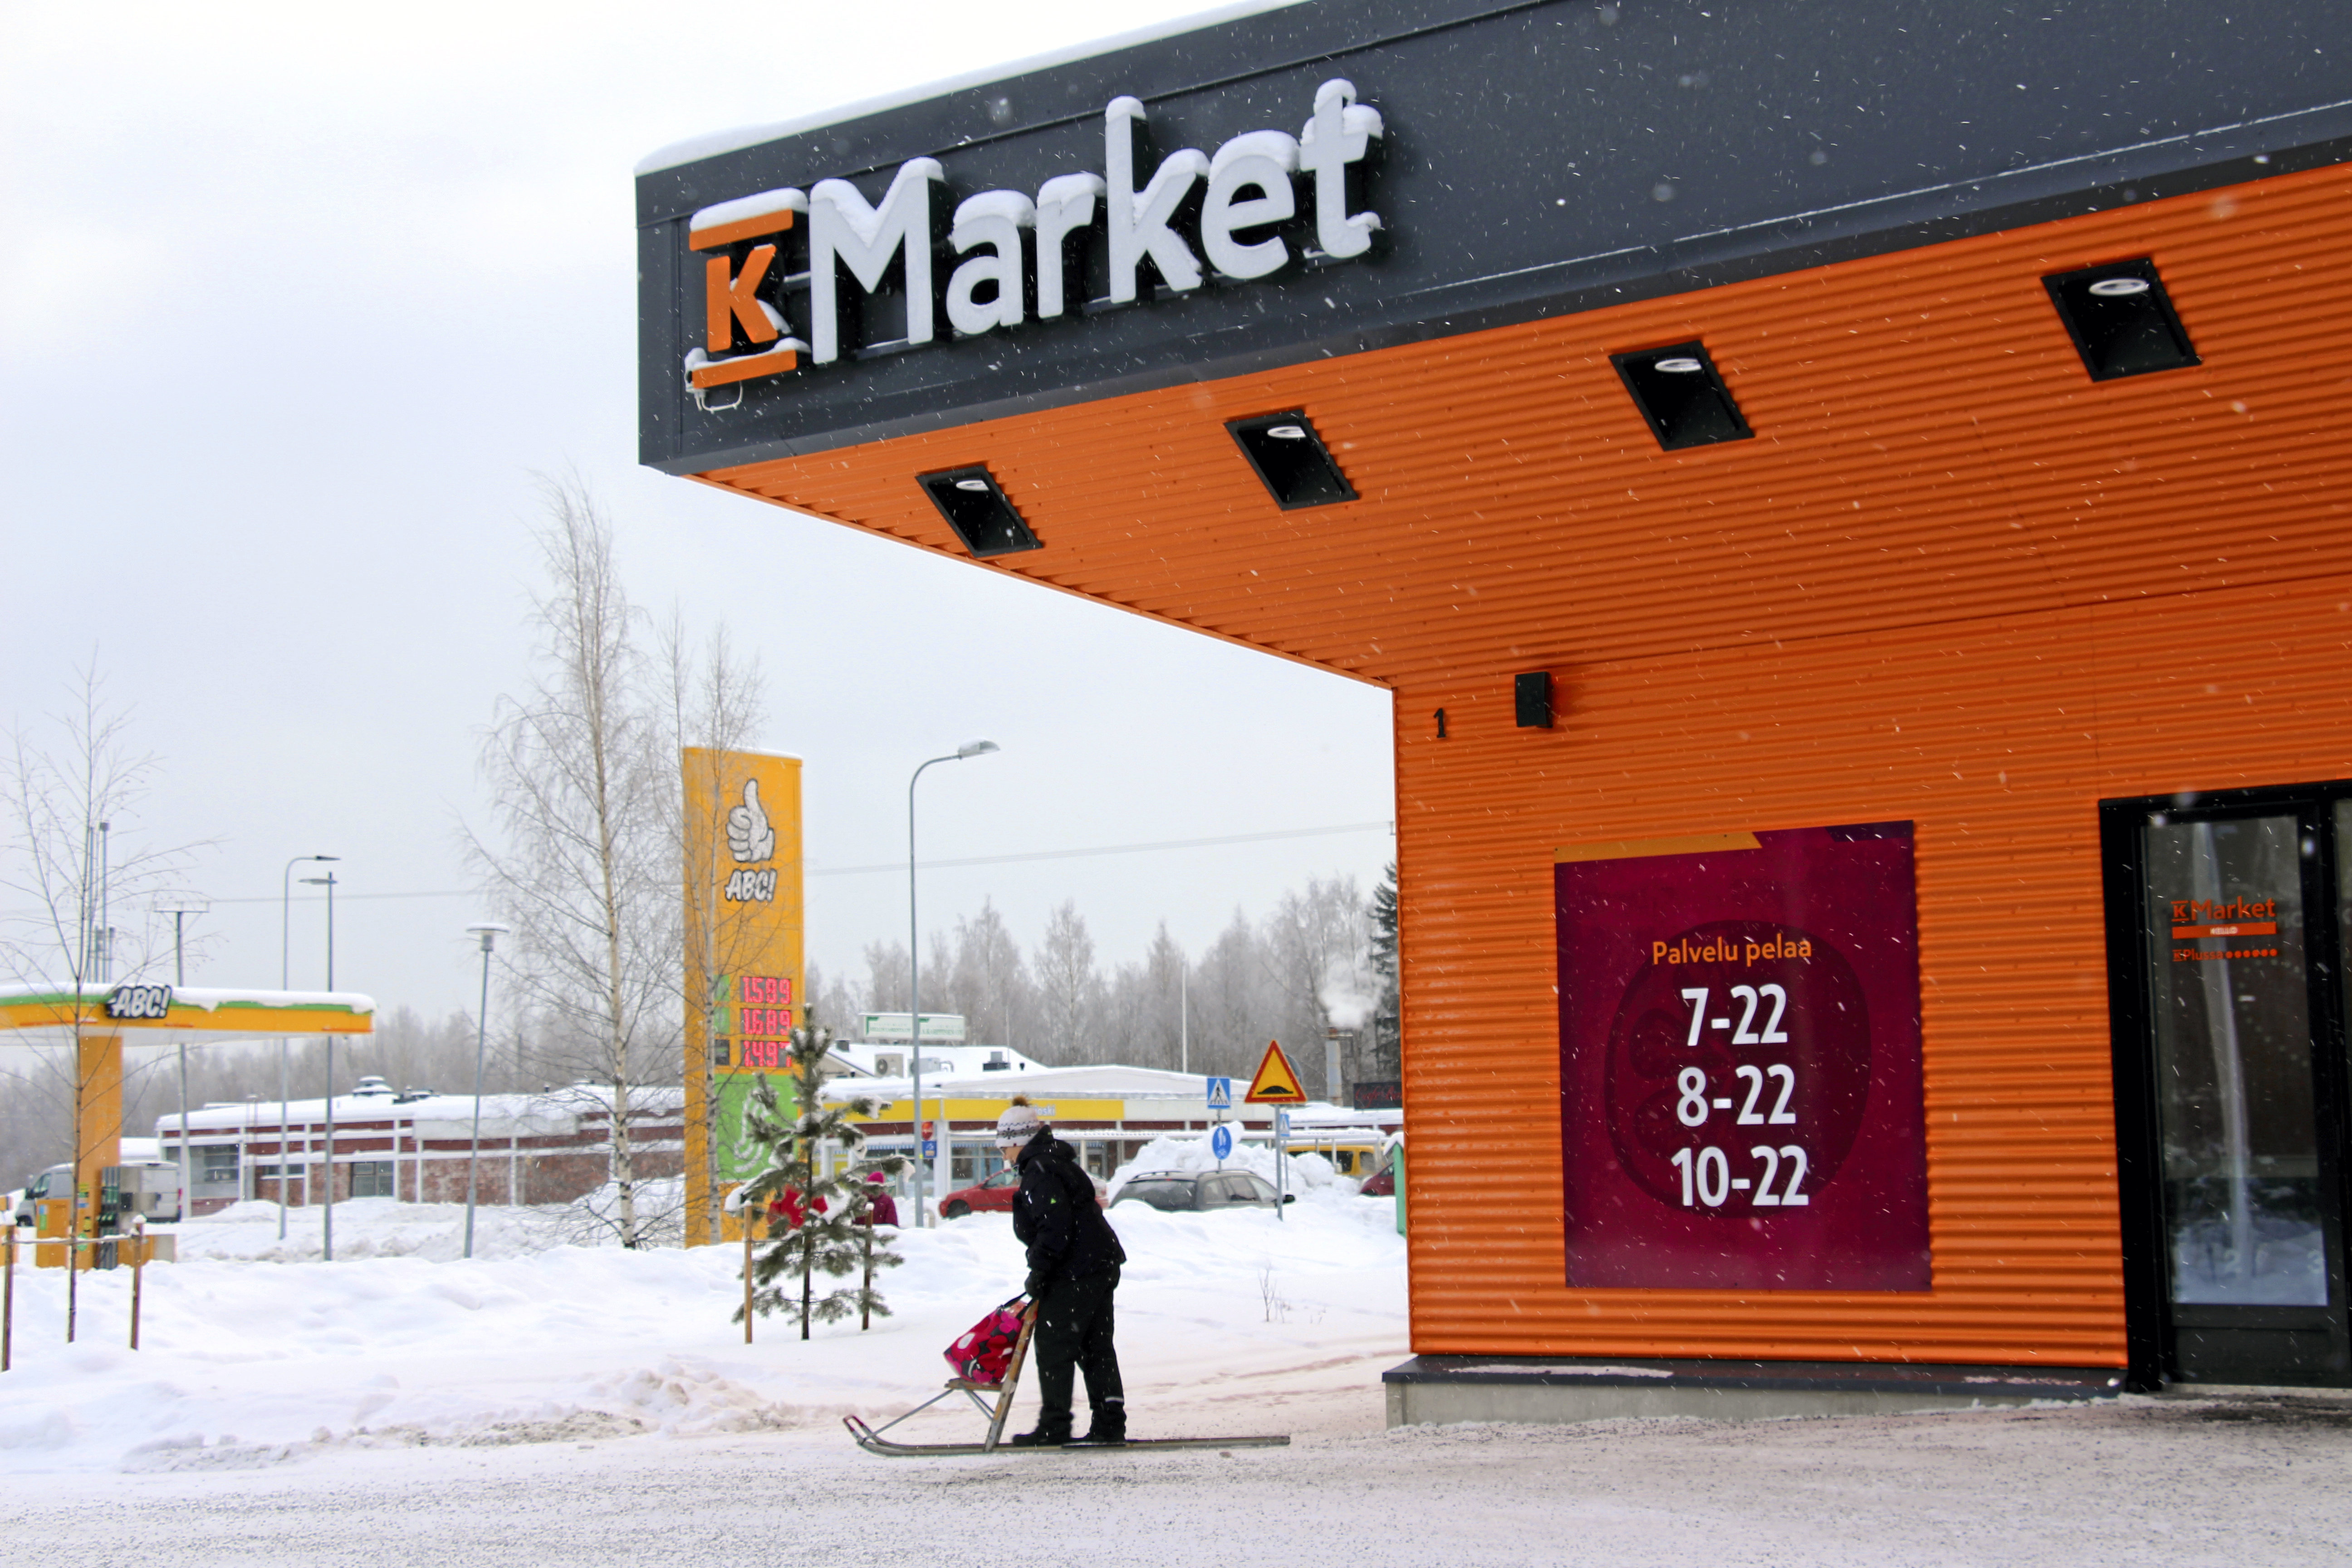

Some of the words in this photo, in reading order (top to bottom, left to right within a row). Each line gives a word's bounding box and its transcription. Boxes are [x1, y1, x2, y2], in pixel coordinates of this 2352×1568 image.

[809, 91, 1377, 364] Market
[1433, 707, 1446, 738] 1
[725, 869, 777, 902] ABC!
[2190, 896, 2276, 921] Market
[1653, 936, 1738, 965] Palvelu
[1745, 934, 1812, 967] pelaa
[2183, 948, 2224, 961] Plussa
[108, 986, 172, 1018] ABC!
[1681, 984, 1788, 1046] 7-22
[1676, 1064, 1797, 1127] 8-22
[1671, 1145, 1809, 1207] 10-22
